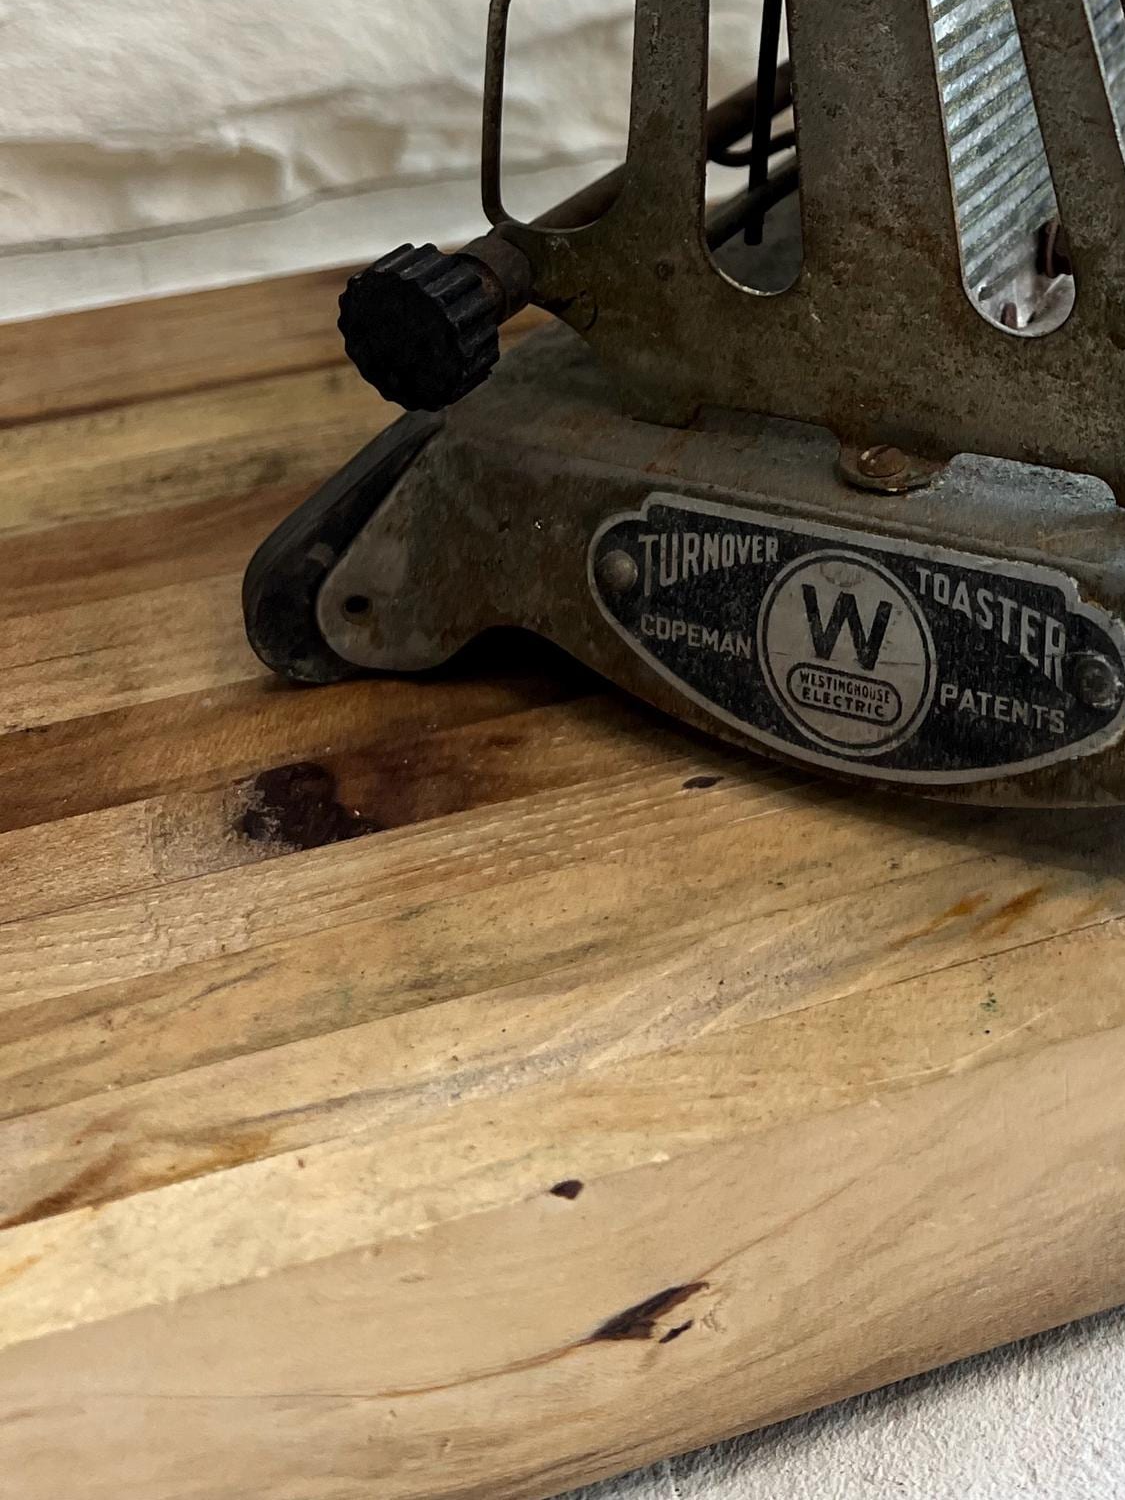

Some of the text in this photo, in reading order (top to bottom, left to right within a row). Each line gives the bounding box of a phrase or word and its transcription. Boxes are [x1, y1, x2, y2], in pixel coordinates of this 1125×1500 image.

[638, 532, 1067, 692] TURNOVER TOASTER
[802, 584, 893, 671] W
[640, 612, 1065, 734] COPEMAN PATENTS
[800, 670, 891, 704] WESTINGHOUSE
[802, 686, 886, 718] ELECTRIC
